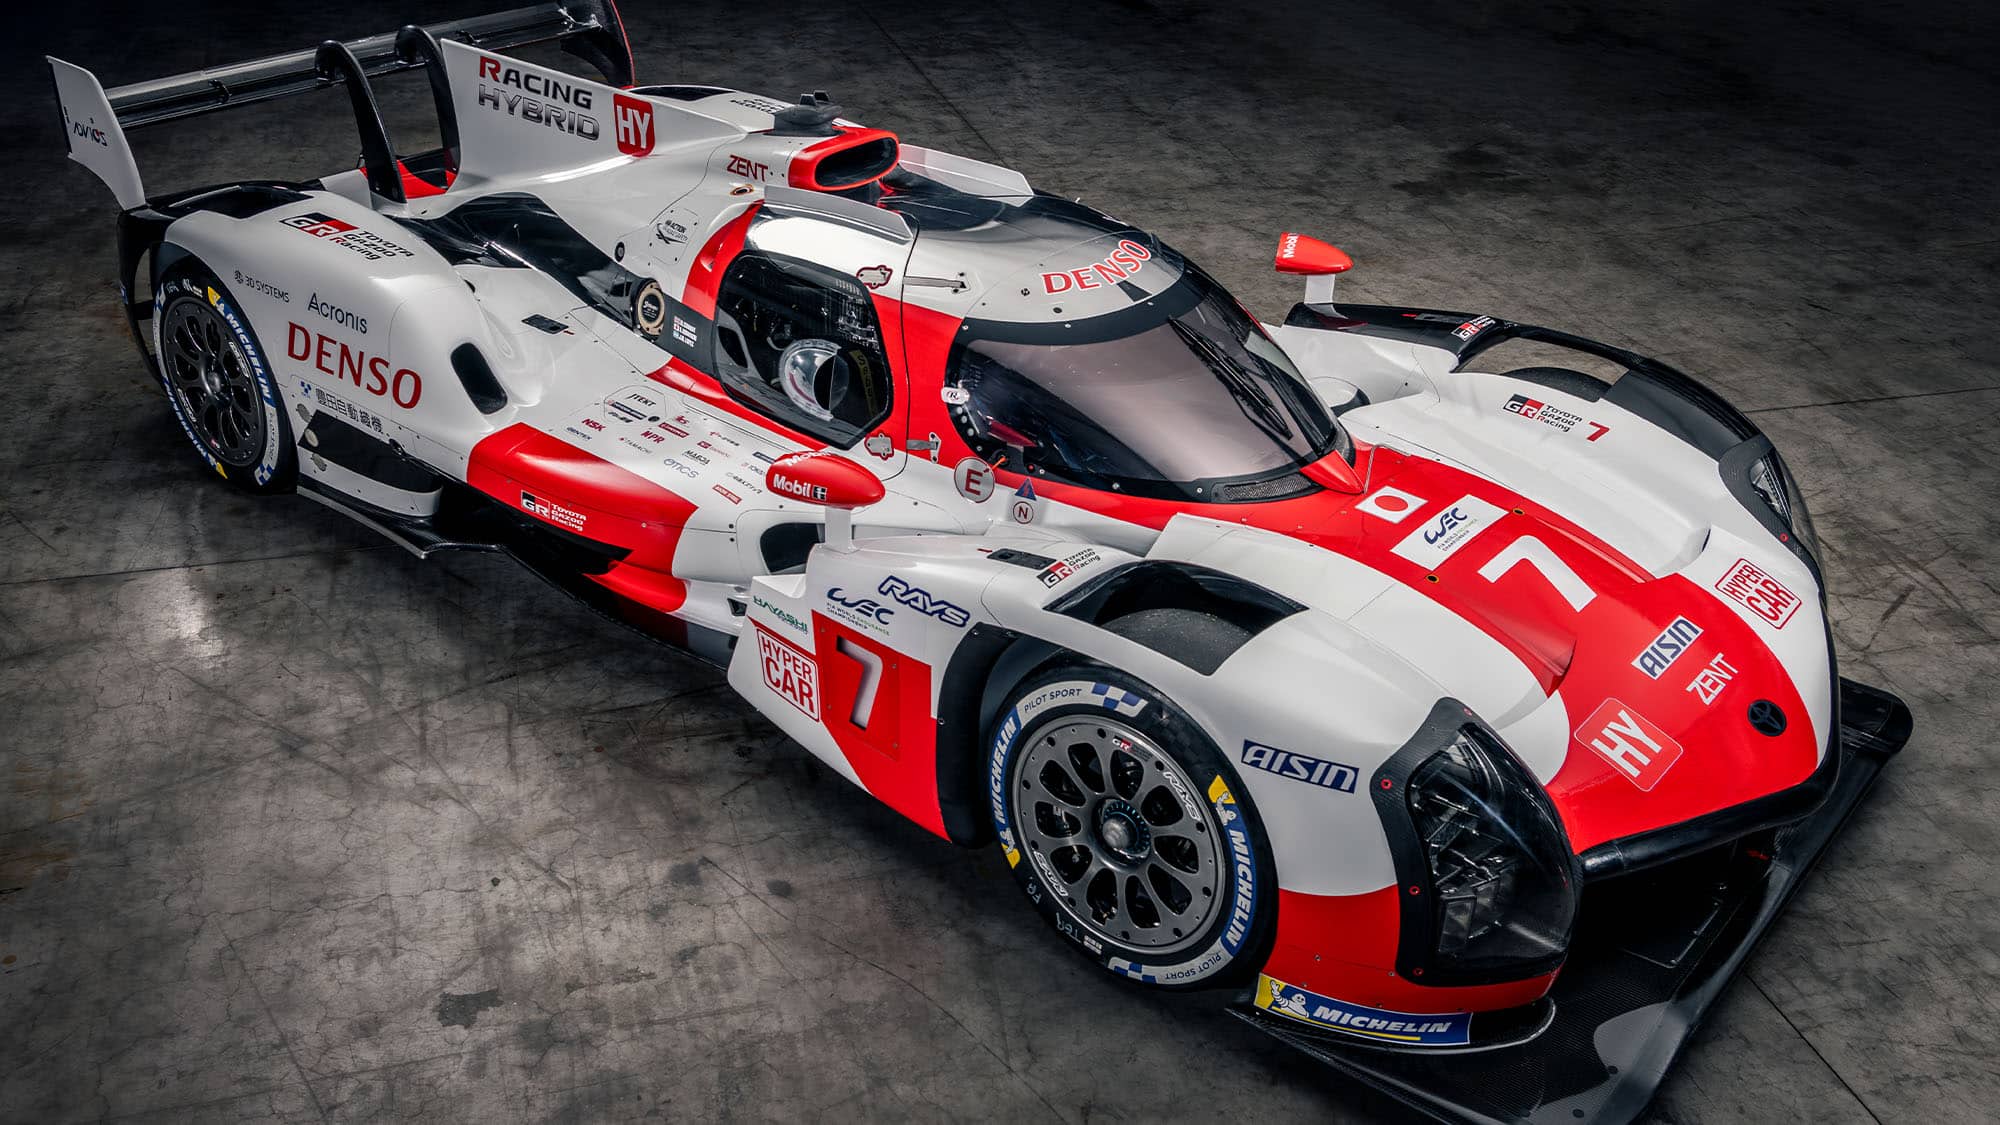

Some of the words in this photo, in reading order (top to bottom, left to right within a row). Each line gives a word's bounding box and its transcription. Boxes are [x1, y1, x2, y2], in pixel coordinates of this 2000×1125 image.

[480, 55, 593, 110] RACING
[479, 83, 600, 141] HYBRID
[615, 105, 651, 149] HY
[727, 154, 768, 182] ZENT
[281, 214, 346, 237] GR
[329, 237, 382, 260] Racing
[343, 234, 397, 257] GAZOO
[359, 230, 415, 257] TOYOTA
[1282, 232, 1298, 259] Mobil
[1041, 239, 1151, 295] DENSO
[255, 280, 290, 303] SYSTEMS
[308, 292, 368, 335] Acronis
[226, 312, 271, 399] MICHELIN
[287, 320, 422, 410] DENSO
[624, 393, 657, 407] JTEKT
[1504, 397, 1540, 418] GR
[1546, 404, 1583, 422] TOYOTA
[581, 418, 606, 432] NSK
[1536, 415, 1571, 433] Racing
[1541, 410, 1576, 427] GAZOO
[1586, 421, 1610, 442] 7
[640, 430, 665, 444] NPR
[663, 458, 700, 479] OTICS
[965, 468, 984, 496] E
[773, 474, 811, 498] Mobil
[522, 497, 549, 518] GR
[551, 503, 587, 521] TOYOTA
[551, 510, 584, 526] GAZOO
[551, 515, 584, 532] Racing
[1423, 507, 1468, 545] WEC
[1068, 551, 1096, 566] GAZOO
[1073, 555, 1101, 571] Racing
[1041, 564, 1072, 588] GR
[1477, 534, 1598, 613] 7
[1723, 564, 1764, 601] HYPER
[827, 587, 895, 625] WEC
[878, 575, 970, 628] RAYS
[1746, 579, 1795, 621] CAR
[761, 635, 812, 684] HYPER
[1639, 619, 1700, 679] AISIN
[765, 655, 815, 714] CAR
[836, 634, 884, 732] 7
[1685, 652, 1739, 706] ZENT
[1024, 693, 1047, 713] PILOT
[1050, 688, 1082, 700] SPORT
[1112, 737, 1131, 751] GR
[1590, 709, 1663, 778] HY
[991, 715, 1018, 825] MICHELIN
[1241, 744, 1356, 791] AISIN
[1222, 828, 1251, 947] MICHELIN
[1164, 967, 1197, 980] SPORT
[1198, 951, 1222, 973] PILOT
[1312, 1005, 1452, 1034] MICHELIN
